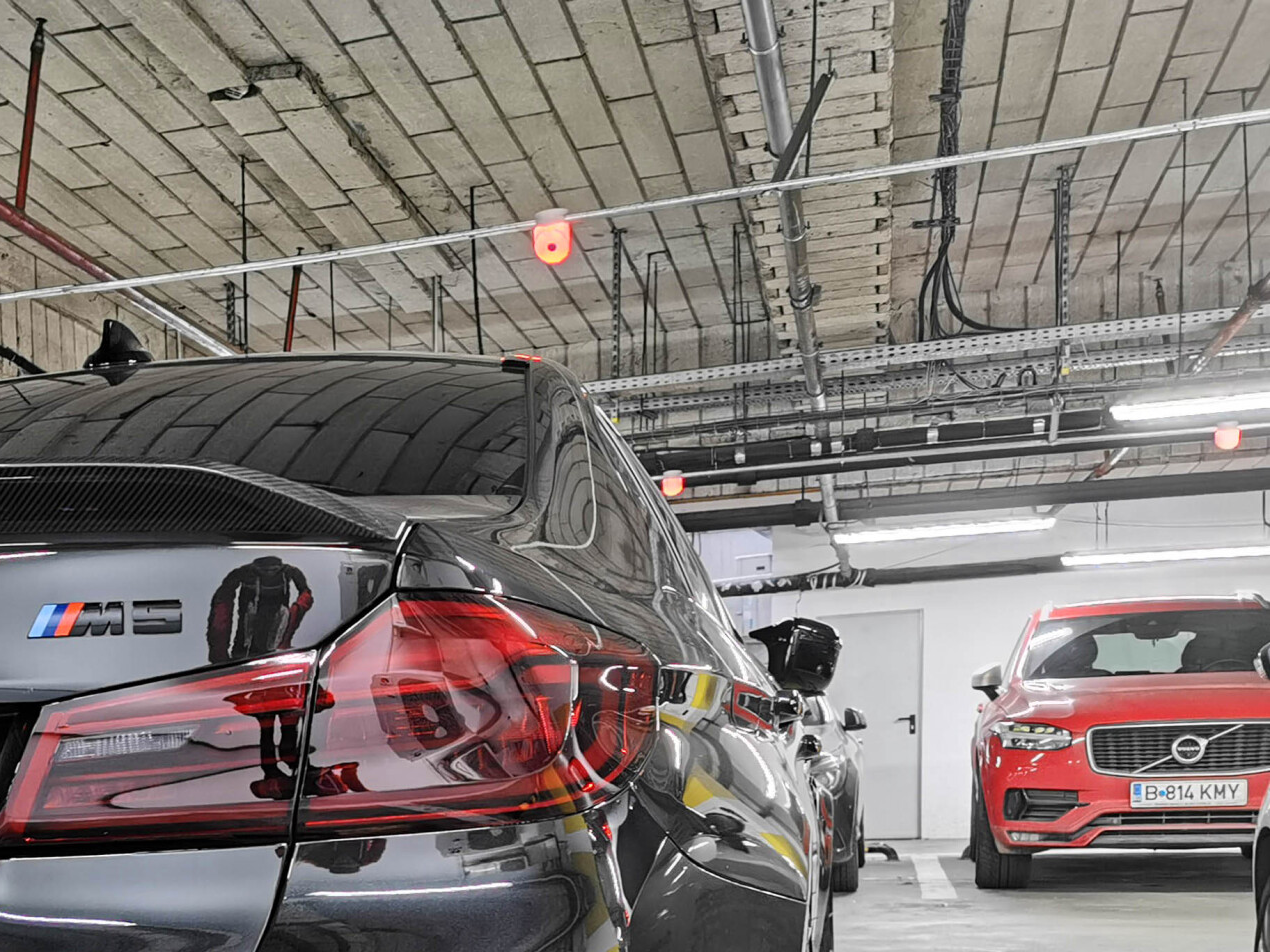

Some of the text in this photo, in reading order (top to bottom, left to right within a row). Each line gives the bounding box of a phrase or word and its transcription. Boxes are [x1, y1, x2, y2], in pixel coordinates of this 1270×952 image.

[68, 599, 182, 636] M5
[1145, 784, 1240, 800] B 814 KMY
